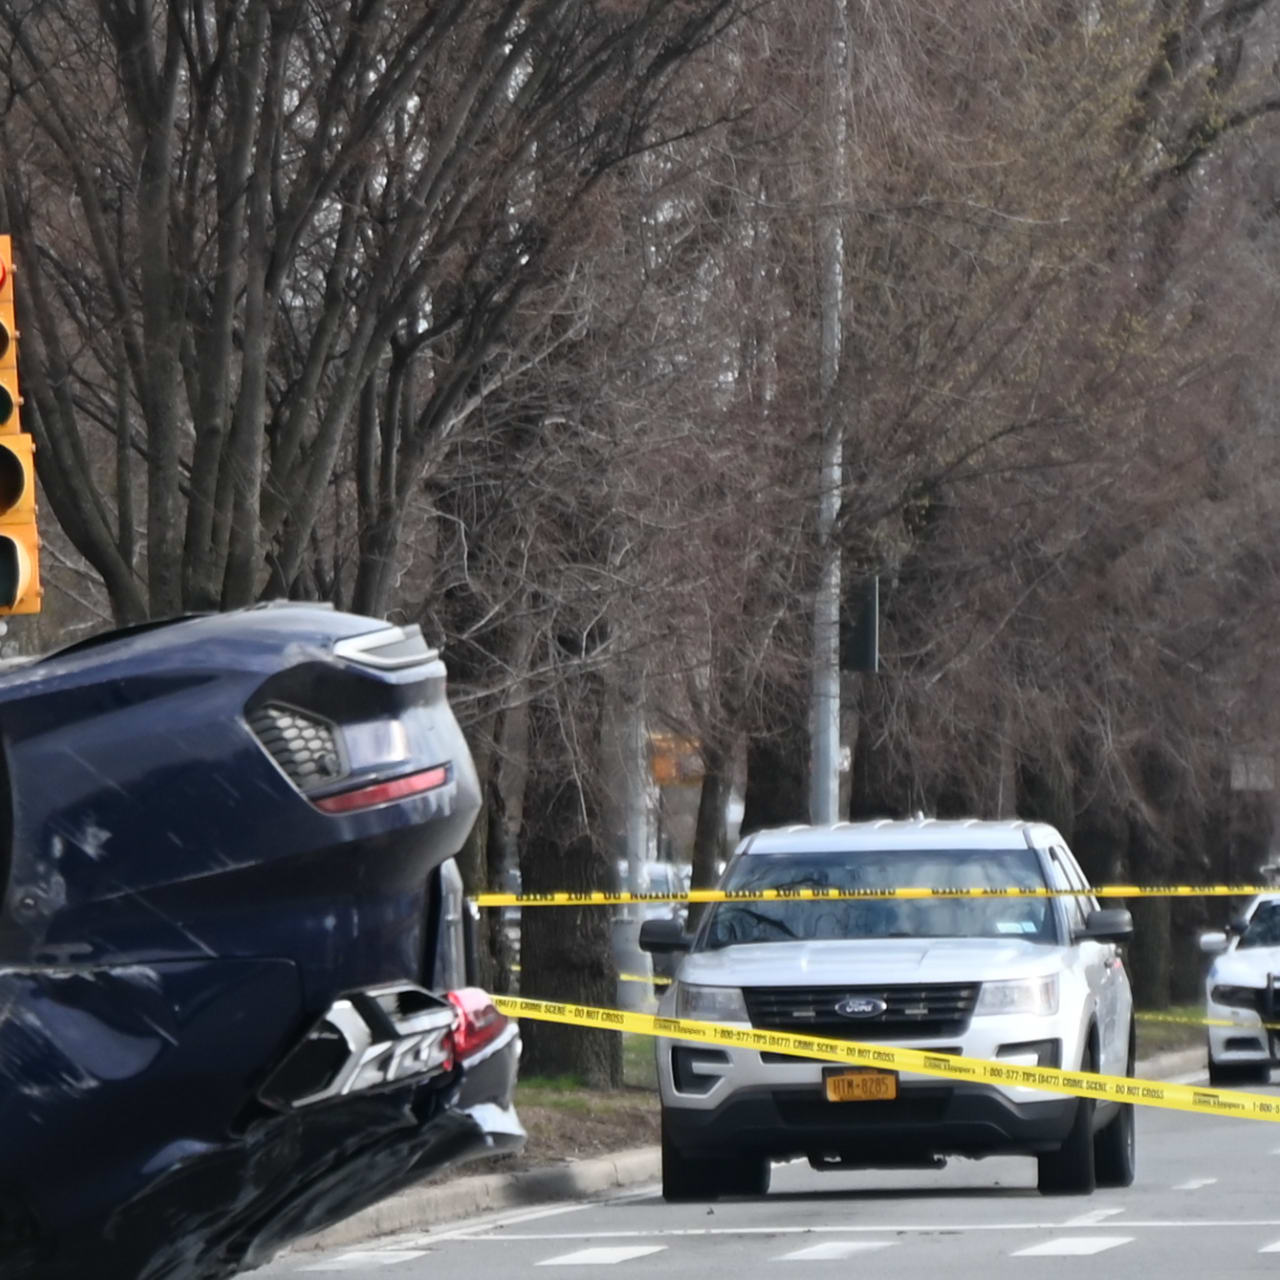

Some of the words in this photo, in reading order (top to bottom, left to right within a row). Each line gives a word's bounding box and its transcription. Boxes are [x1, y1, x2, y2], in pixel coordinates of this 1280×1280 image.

[520, 998, 542, 1012] CRIME
[544, 1004, 566, 1015] SCENE
[574, 1007, 584, 1018] DO
[586, 1009, 600, 1020] NOT
[601, 1011, 624, 1024] CROSS
[817, 1043, 838, 1054] SCENE
[846, 1047, 856, 1056] DO
[857, 1048, 871, 1058] NOT
[872, 1050, 894, 1062] CROSS
